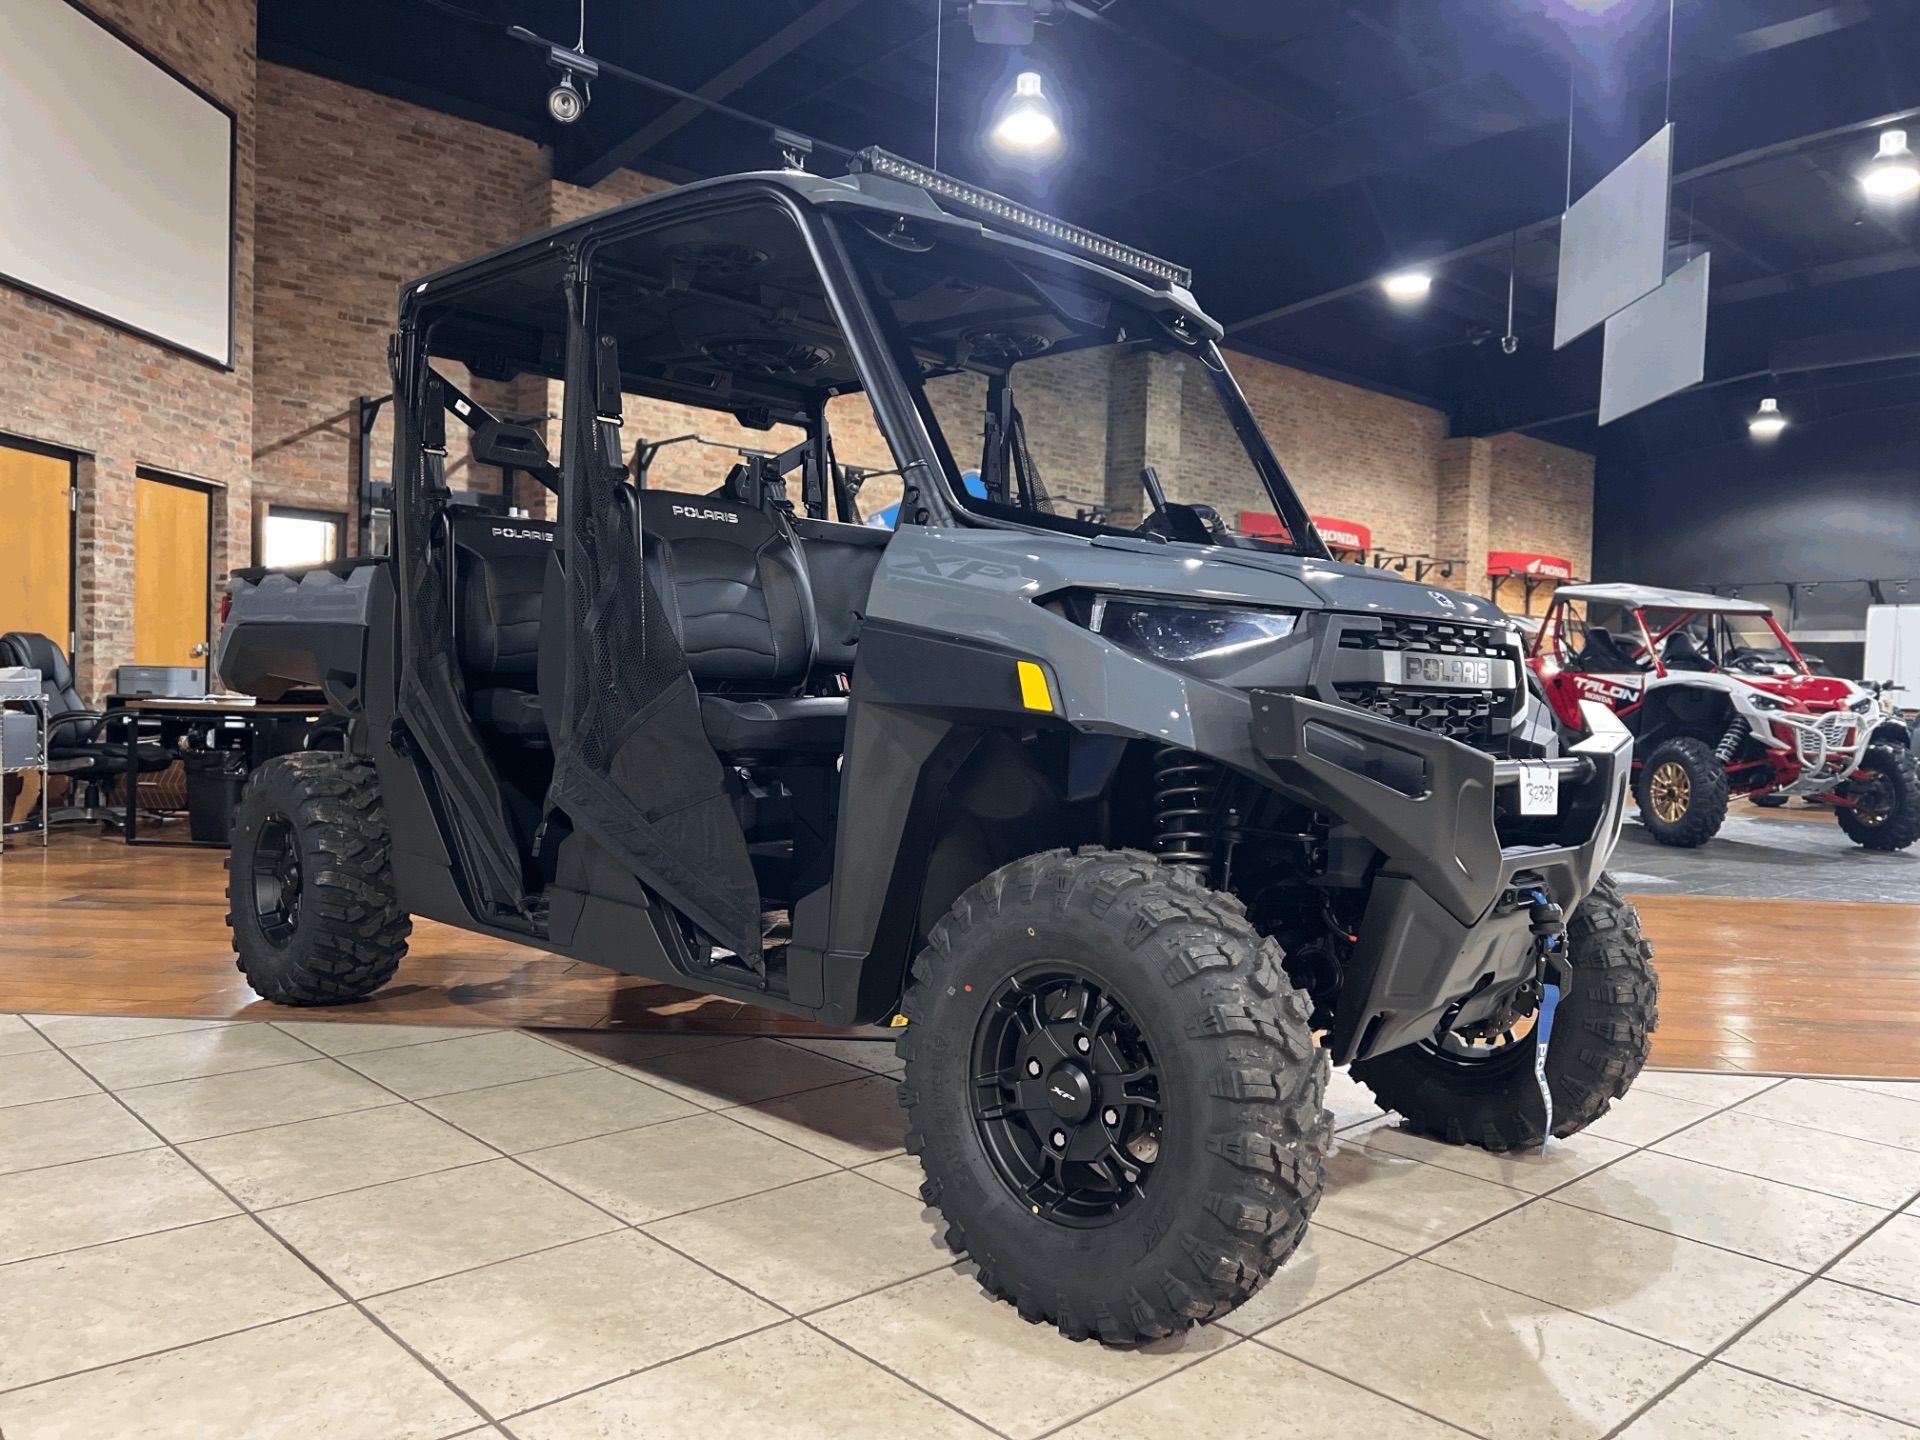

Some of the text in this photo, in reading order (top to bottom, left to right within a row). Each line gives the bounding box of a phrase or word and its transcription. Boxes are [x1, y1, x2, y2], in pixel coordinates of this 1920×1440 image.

[672, 505, 739, 524] POLARIS
[491, 527, 554, 542] POLARIS
[1316, 528, 1360, 547] HONDA
[892, 548, 1020, 581] XP
[1405, 656, 1490, 684] POLARIS
[1573, 676, 1640, 703] TALON
[1584, 691, 1613, 705] HONDA
[1050, 1086, 1075, 1101] XP
